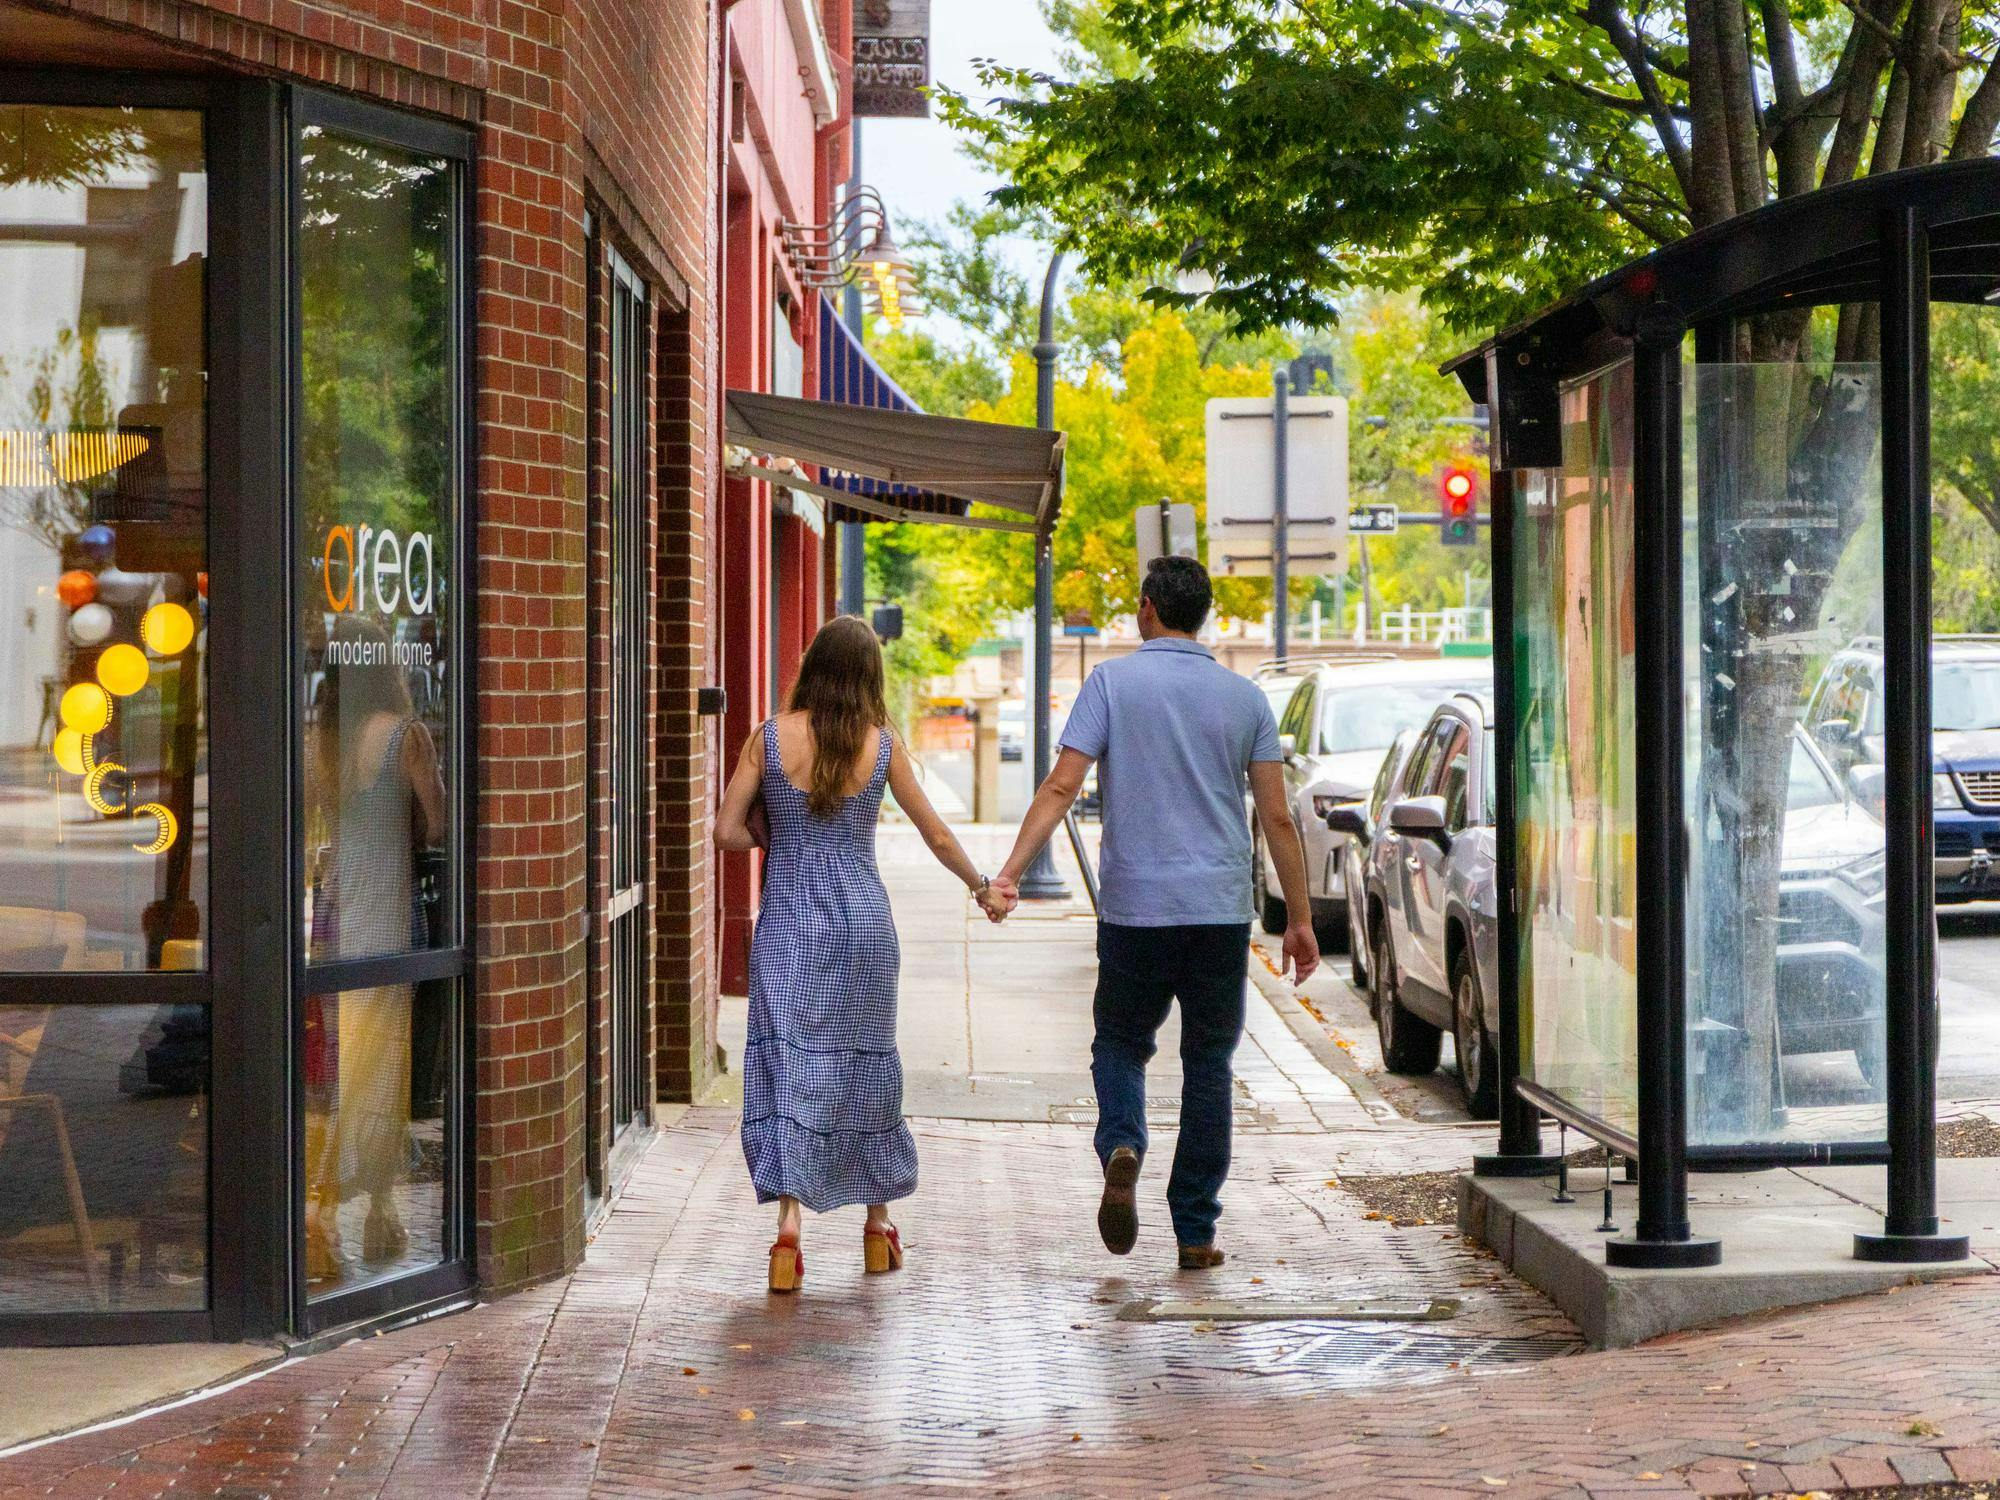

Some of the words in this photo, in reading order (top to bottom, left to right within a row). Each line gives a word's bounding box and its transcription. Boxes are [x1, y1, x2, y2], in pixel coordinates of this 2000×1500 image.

[324, 525, 432, 615] area
[328, 634, 387, 666] modern
[392, 634, 432, 666] home
